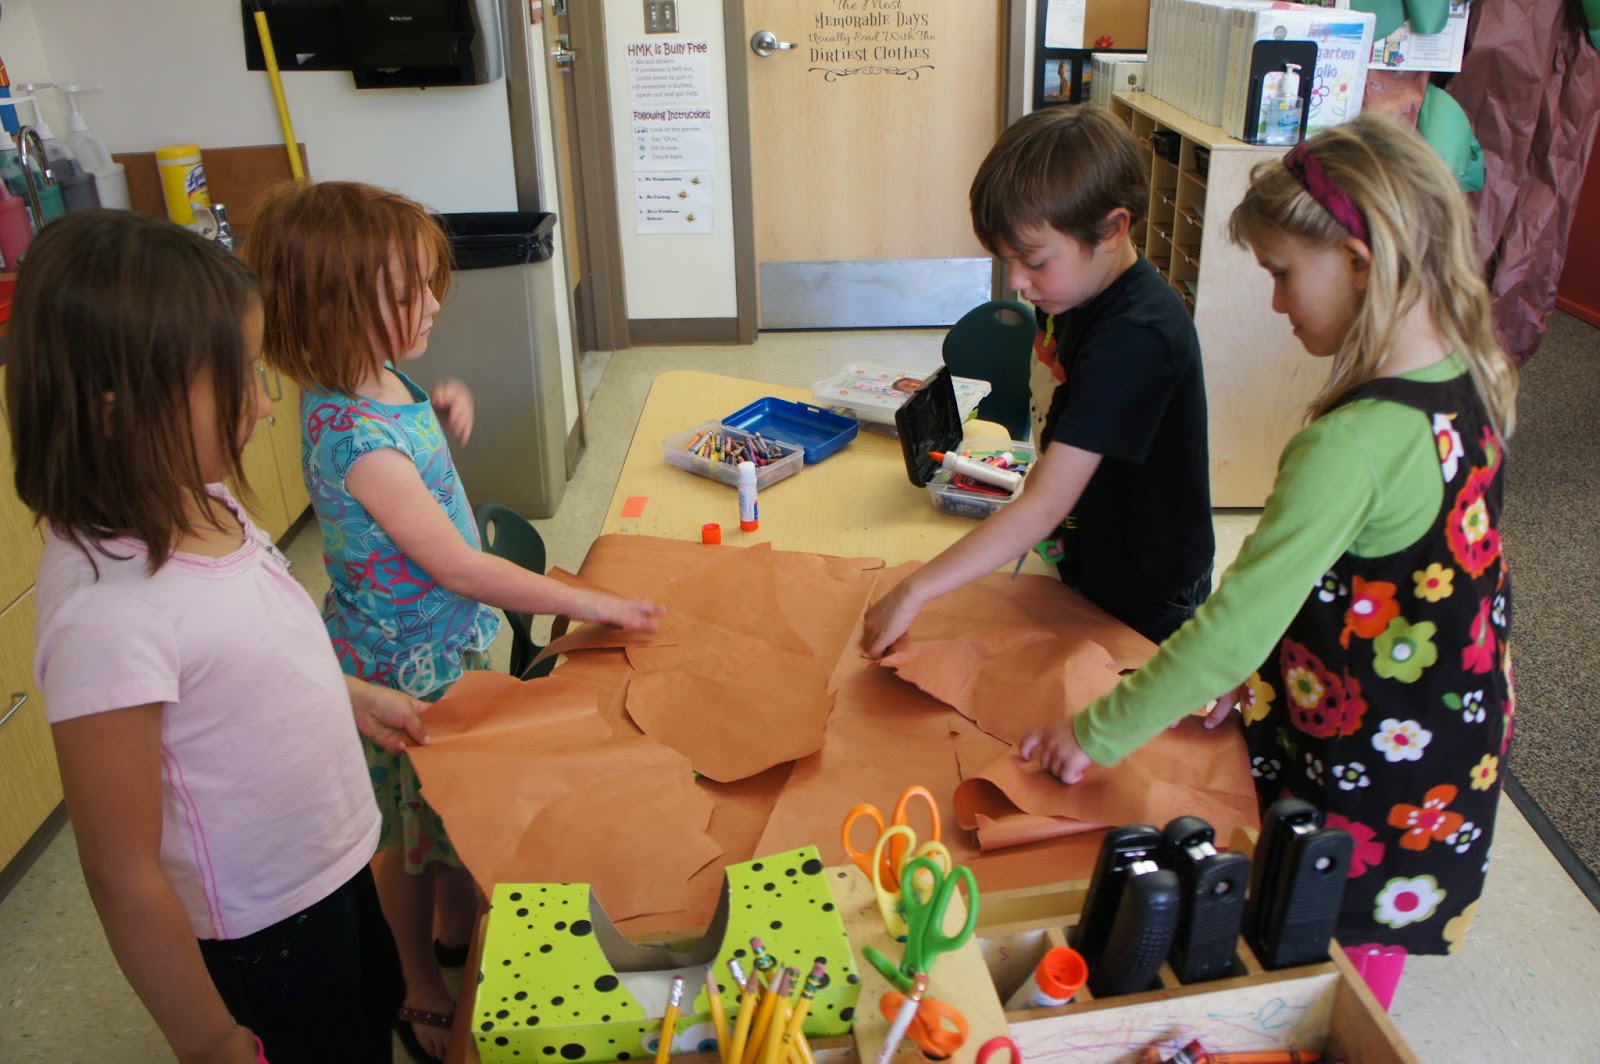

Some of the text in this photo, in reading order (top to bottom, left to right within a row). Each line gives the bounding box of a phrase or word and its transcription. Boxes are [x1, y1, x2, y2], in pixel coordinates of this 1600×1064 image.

[896, 11, 929, 31] Days
[808, 30, 936, 46] Usually End With The
[627, 42, 708, 57] HMK is Bully Free
[676, 74, 687, 82] join
[633, 110, 711, 121] Following Instructions
